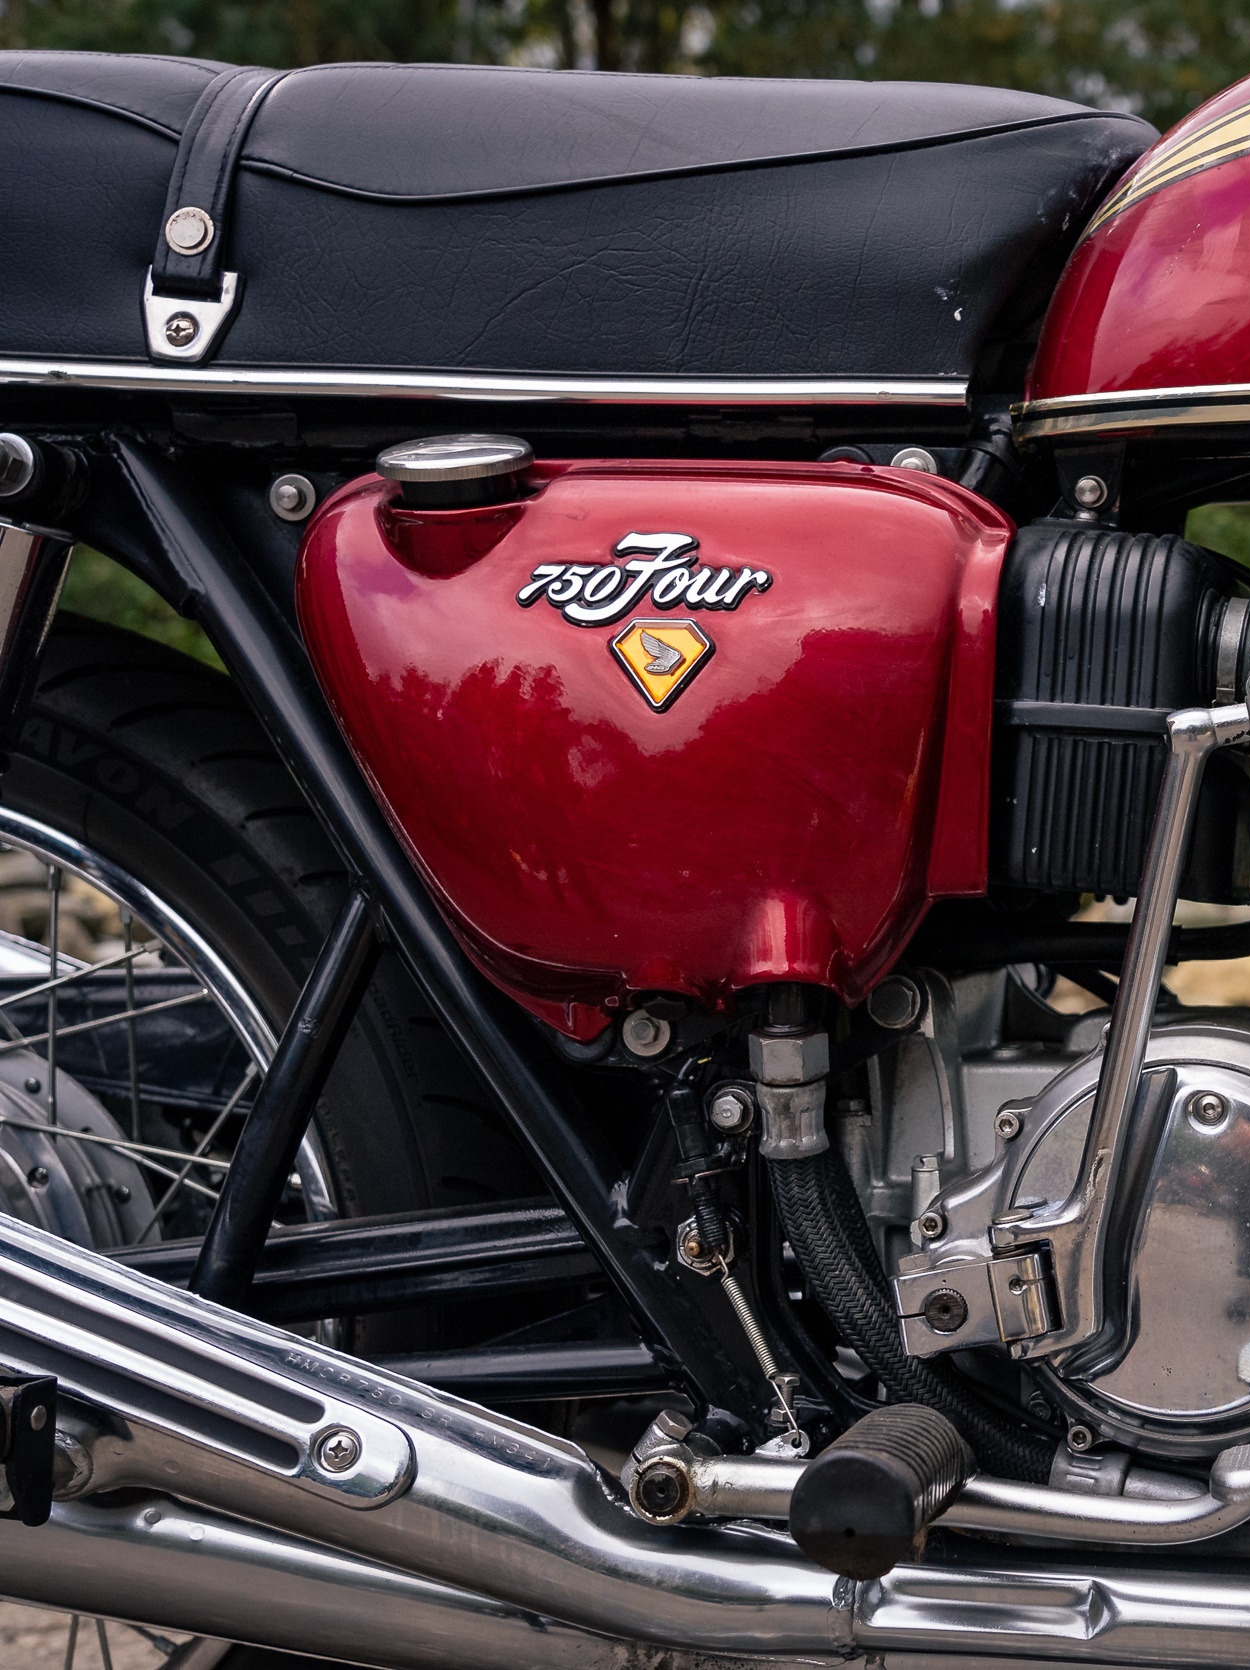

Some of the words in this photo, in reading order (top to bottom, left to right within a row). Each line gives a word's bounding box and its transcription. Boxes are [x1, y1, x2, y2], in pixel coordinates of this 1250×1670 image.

[517, 564, 622, 604] 750
[562, 531, 770, 623] Four
[16, 714, 195, 830] AVON
[421, 1407, 453, 1427] SR
